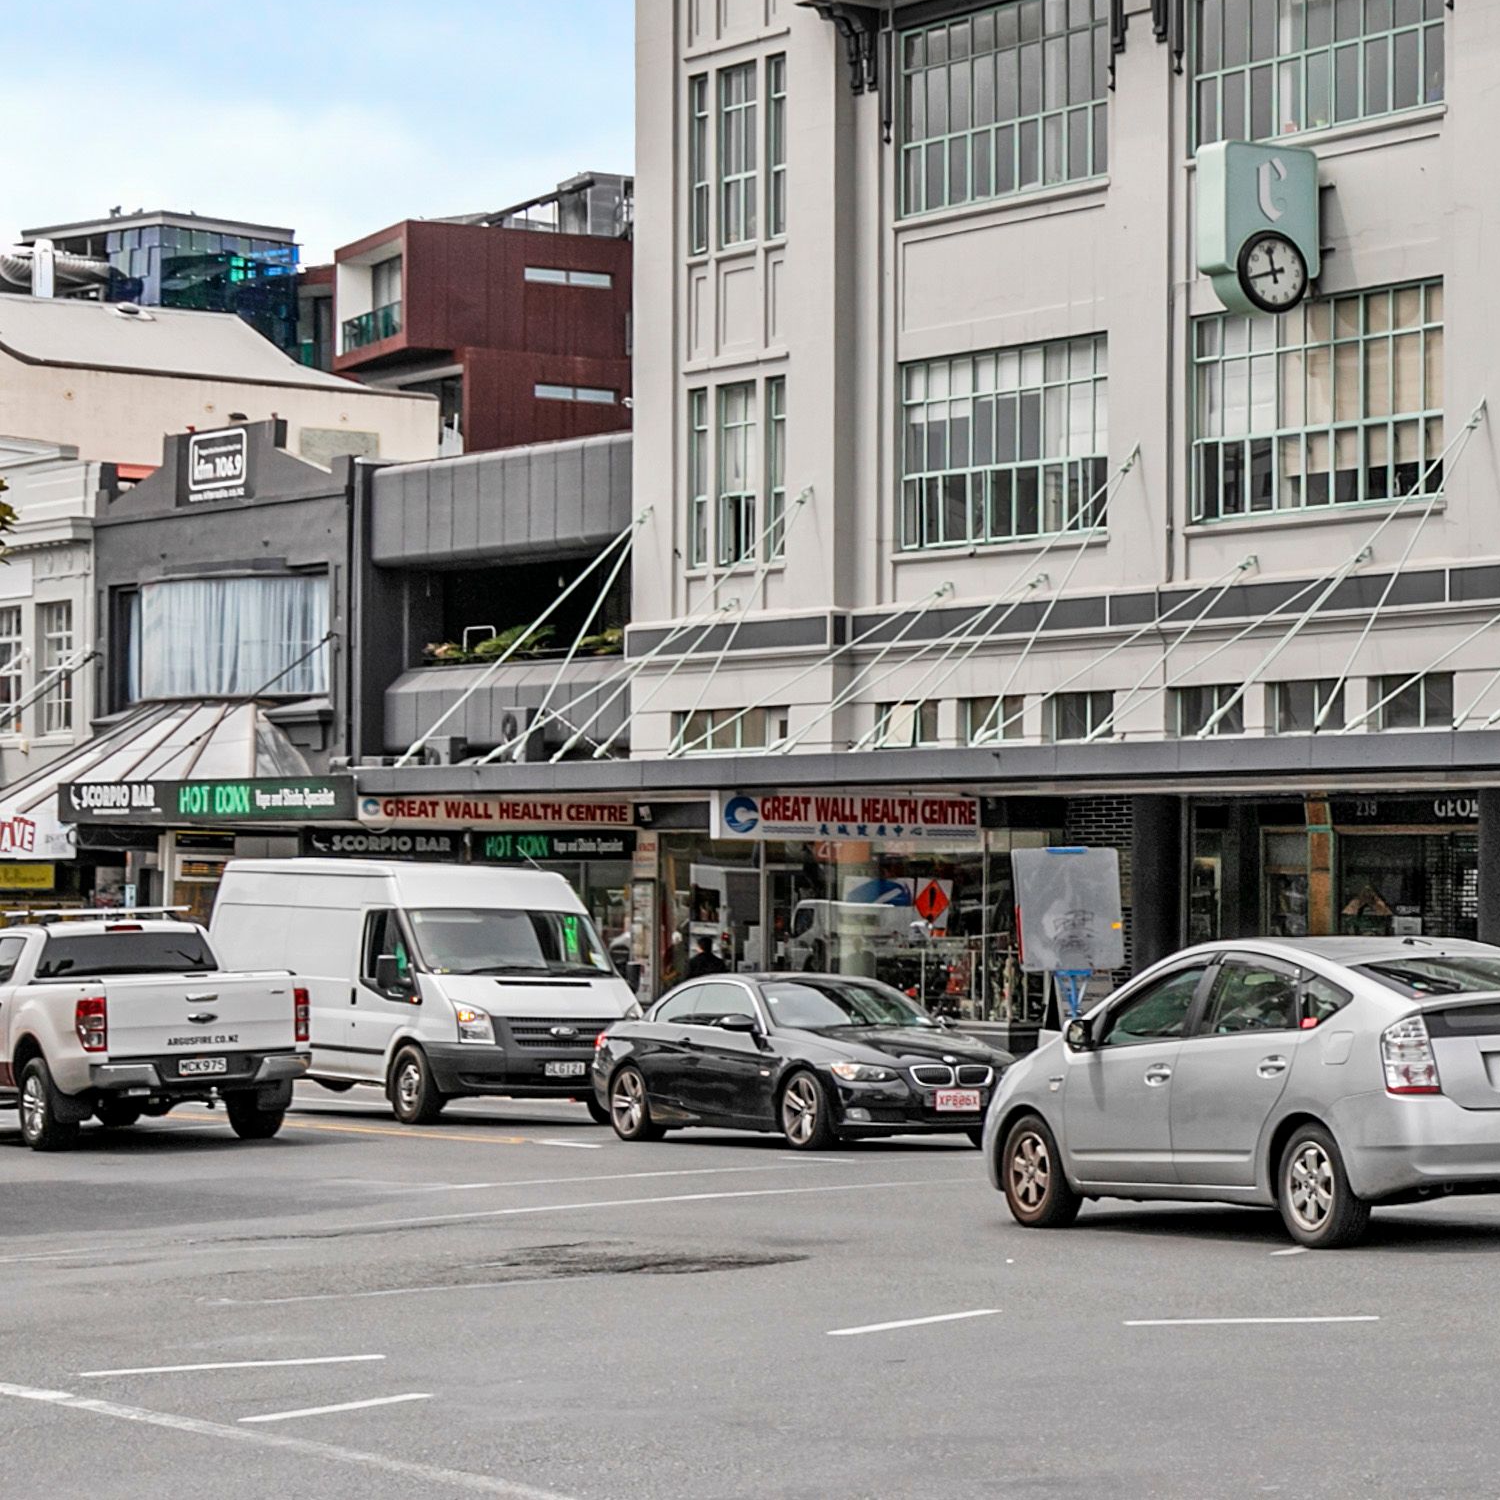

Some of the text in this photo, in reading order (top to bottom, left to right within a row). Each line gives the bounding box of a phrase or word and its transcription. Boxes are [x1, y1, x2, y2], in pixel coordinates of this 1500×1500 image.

[215, 454, 242, 478] 106.9
[81, 784, 155, 808] SCORPIO BAR
[179, 785, 210, 813] HOT
[383, 799, 629, 823] GREAT WALL HEALTH CENTRE
[760, 797, 977, 826] GREAT WALL HEALTH CENTRE
[331, 834, 452, 852] SCORPIO BAR
[485, 835, 513, 858] HOT
[167, 1034, 240, 1046] ARGUSFIRE.CO.NZ
[180, 1060, 226, 1073] MCK975
